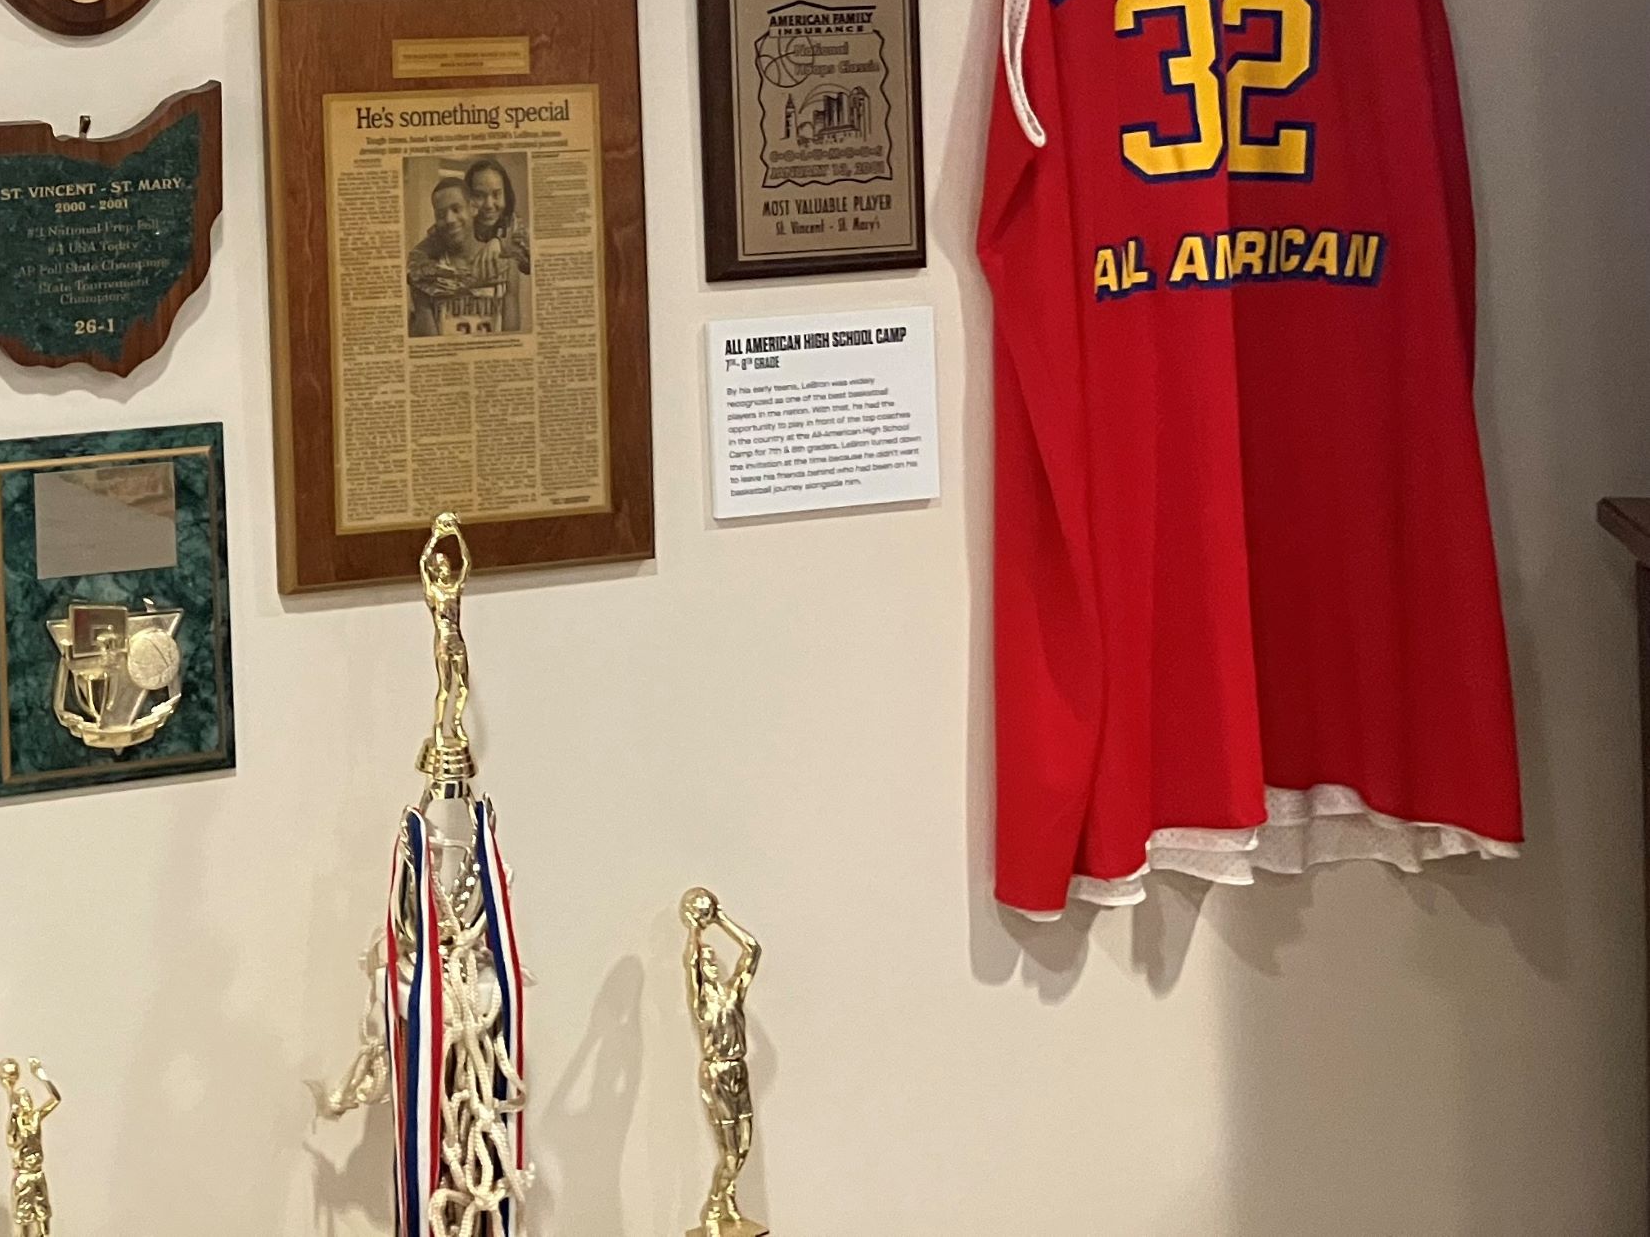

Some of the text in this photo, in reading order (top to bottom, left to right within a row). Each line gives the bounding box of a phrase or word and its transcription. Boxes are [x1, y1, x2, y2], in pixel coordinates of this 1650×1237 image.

[770, 12, 873, 26] AMERICAN FAMILY
[778, 26, 863, 35] INSURANCE
[356, 99, 570, 129] He's something special
[28, 183, 96, 199] VINCENT
[138, 178, 182, 191] MARY
[55, 200, 129, 213] 2000 2001
[762, 194, 892, 216] MOST VALUABLE PLAYER
[75, 318, 115, 335] 26-1
[725, 327, 907, 355] ALL AMERICAN HIGH SCHOOL CAMP
[754, 356, 780, 369] GRADE
